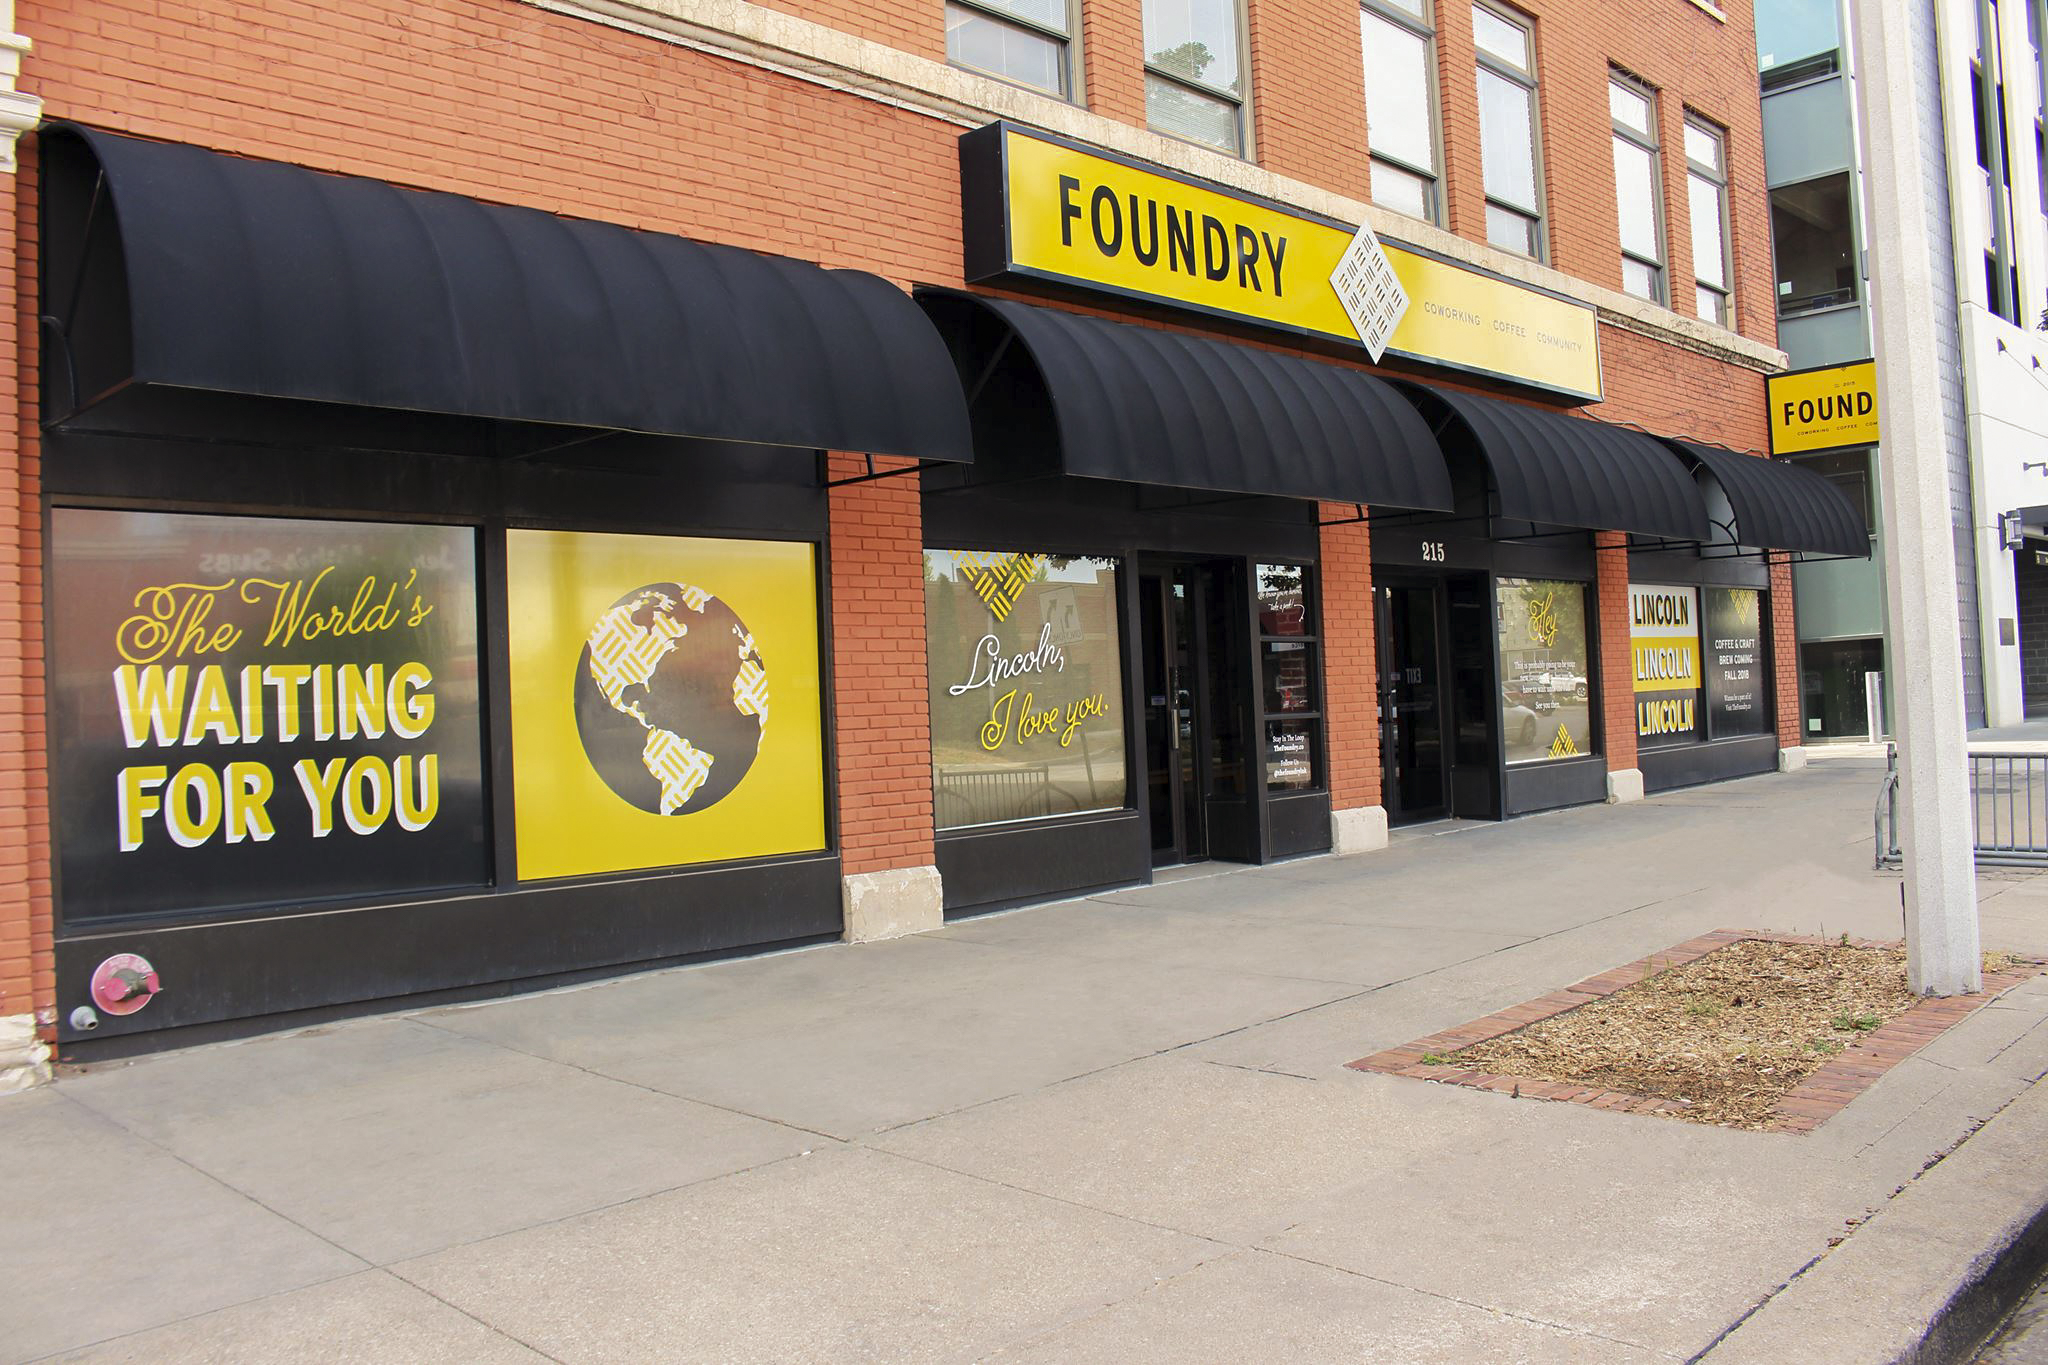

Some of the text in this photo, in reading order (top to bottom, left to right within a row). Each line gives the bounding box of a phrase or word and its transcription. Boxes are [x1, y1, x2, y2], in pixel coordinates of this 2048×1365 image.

[1059, 174, 1288, 297] FOUNDRY
[1424, 301, 1583, 352] COWORKING COFFEE COMMUNITY
[1797, 428, 1830, 436] COWORKING
[1836, 423, 1858, 431] COFFEE
[1422, 541, 1445, 562] 215
[116, 565, 434, 664] The World's
[1528, 592, 1558, 647] Hey
[1633, 593, 1689, 627] LINCOLN
[949, 622, 1064, 696] Lincoln,
[1714, 638, 1755, 650] COFFEE & CRAFT
[1719, 654, 1753, 665] BREW COMING
[1636, 647, 1691, 682] LINCOLN
[1724, 670, 1737, 680] FALL
[113, 661, 436, 748] WAITING
[980, 689, 1108, 751] I love you.
[1638, 698, 1694, 736] LINCOLN
[1273, 735, 1281, 743] Stay
[1294, 734, 1305, 742] Loop
[1280, 759, 1293, 767] Follow
[117, 754, 439, 852] FOR YOU
